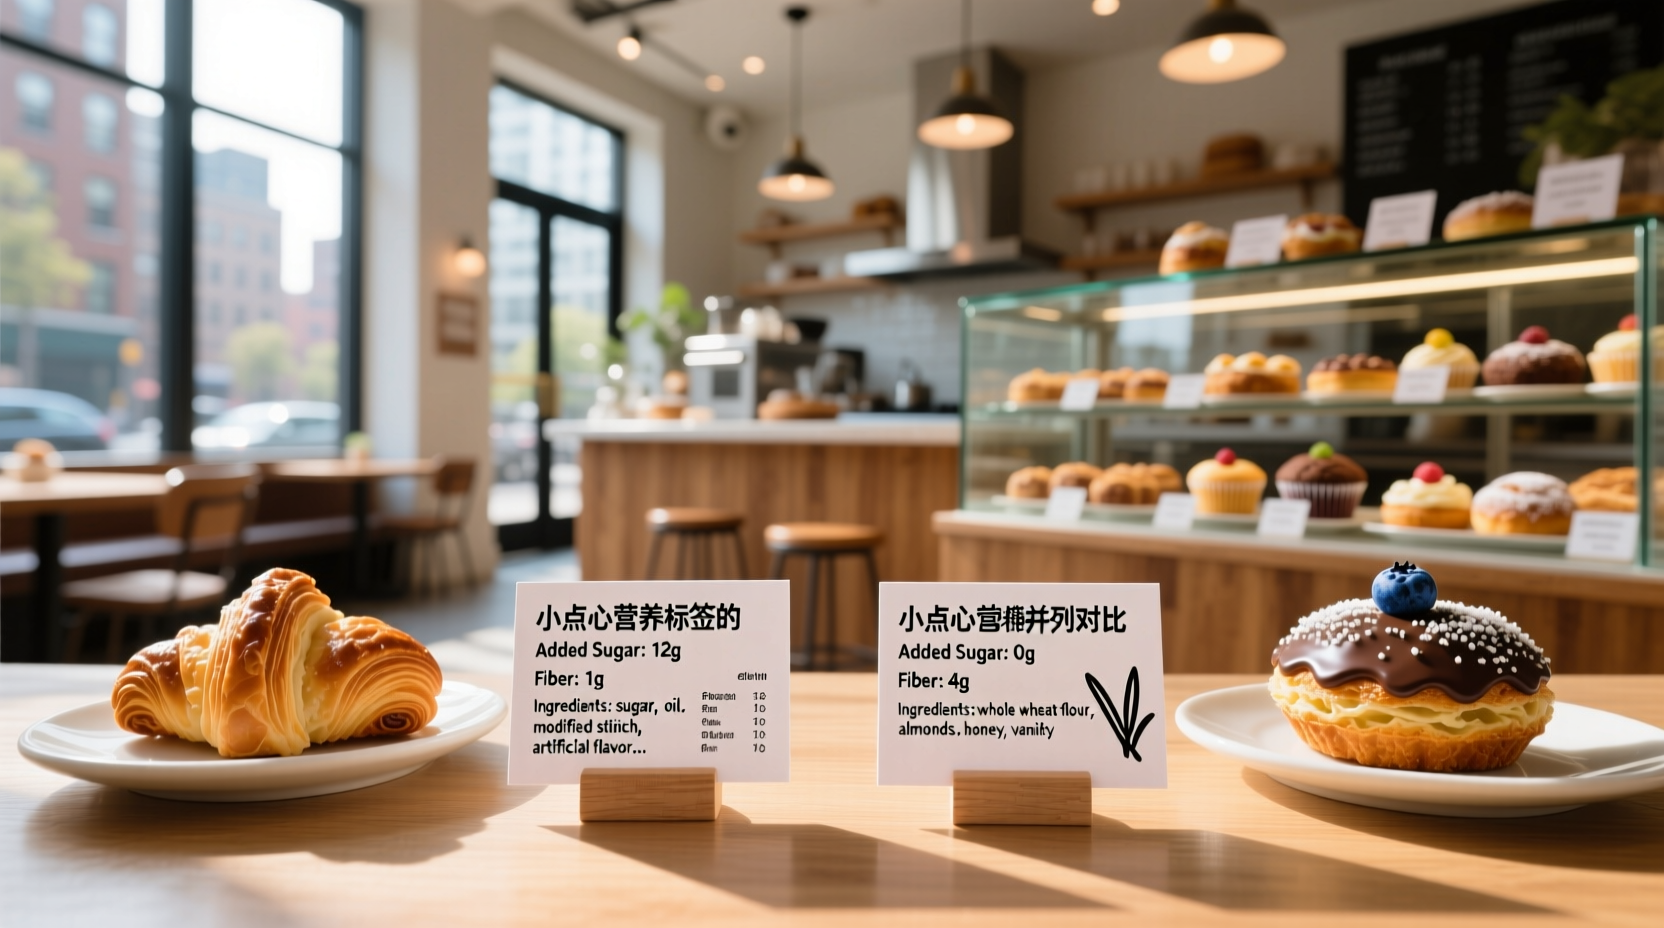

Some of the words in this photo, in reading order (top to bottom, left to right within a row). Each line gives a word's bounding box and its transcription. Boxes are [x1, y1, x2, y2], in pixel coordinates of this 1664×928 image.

[536, 602, 740, 631] 小点心营养标签的
[535, 641, 587, 658] Added
[593, 641, 645, 662] Sugar:
[652, 641, 681, 662] 12g
[898, 643, 951, 660] Added
[956, 644, 1008, 665] Sugar:
[1014, 644, 1035, 665] 0g
[535, 670, 578, 686] Fiber:
[586, 671, 604, 690] 1g
[899, 671, 943, 688] Fiber:
[948, 672, 969, 693] 4g
[534, 698, 612, 717] Ingredients:
[616, 702, 658, 716] sugar,
[977, 702, 1015, 716] whole
[1019, 702, 1057, 716] wheat
[1060, 702, 1094, 720] flour,
[534, 719, 592, 733] modified
[964, 721, 1006, 740] honey,
[593, 739, 646, 754] flavor...
